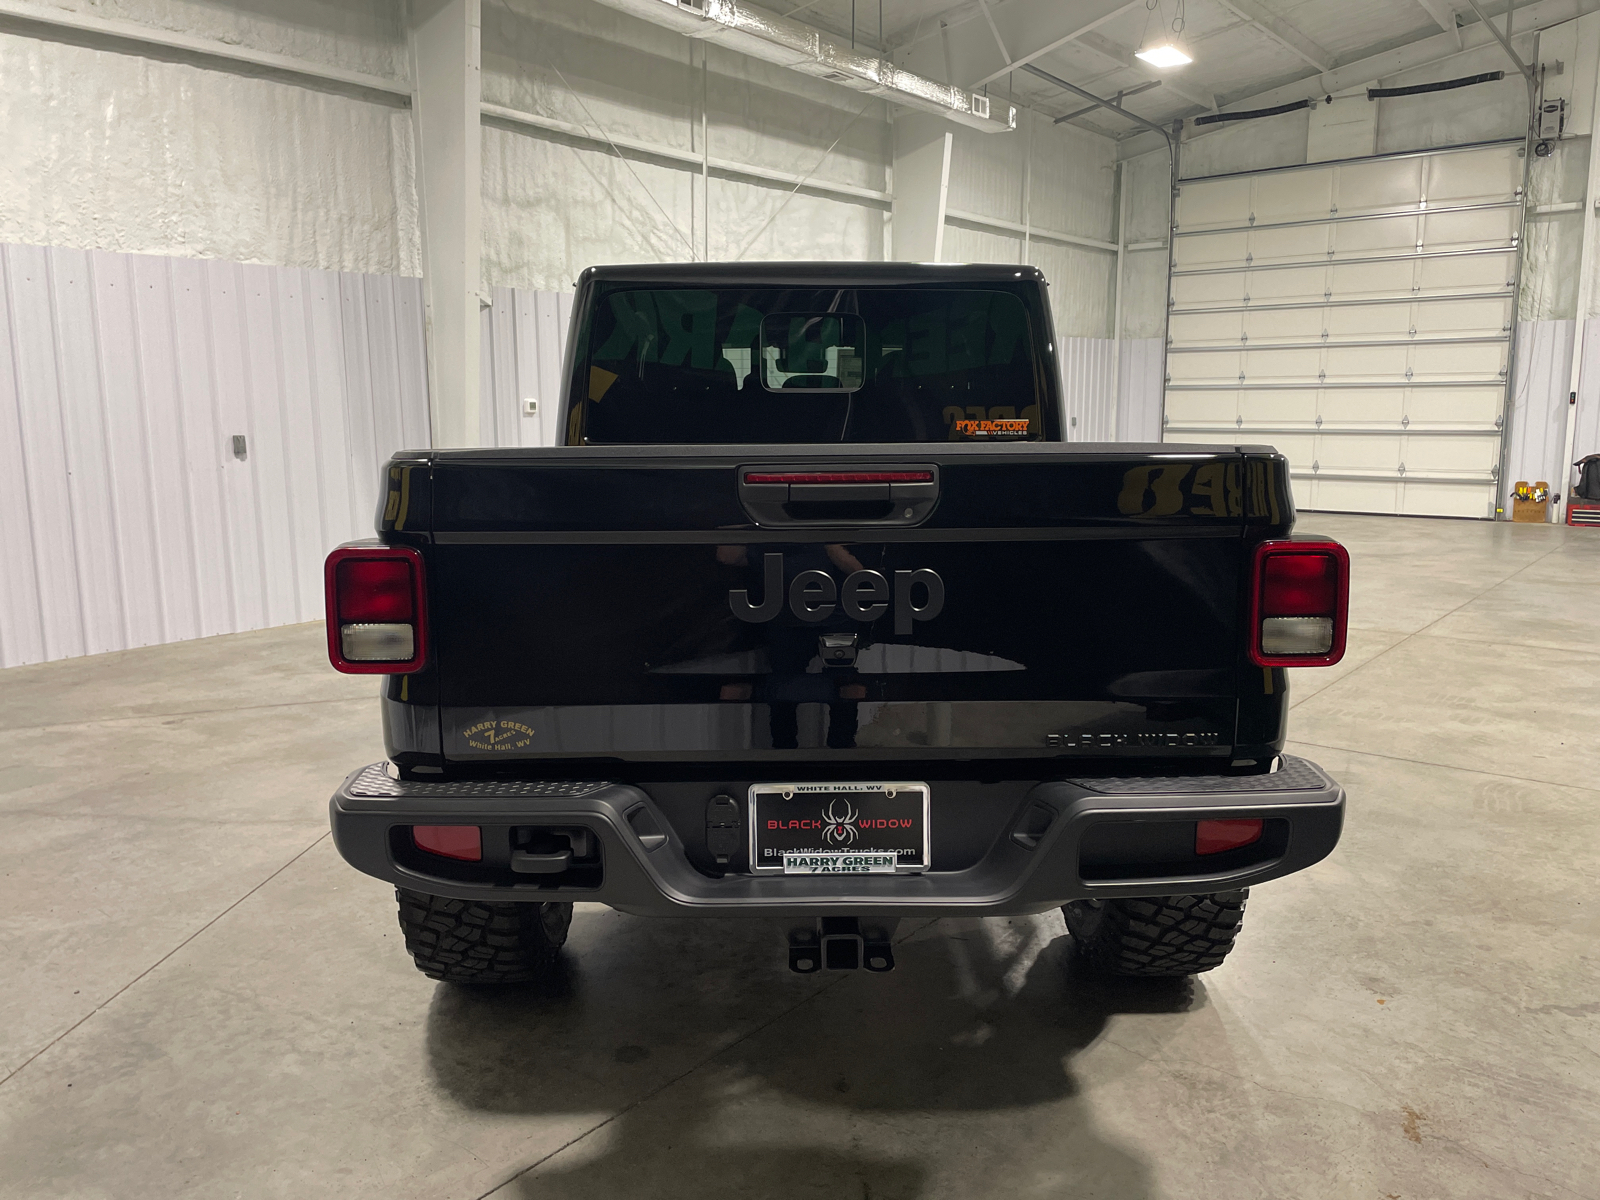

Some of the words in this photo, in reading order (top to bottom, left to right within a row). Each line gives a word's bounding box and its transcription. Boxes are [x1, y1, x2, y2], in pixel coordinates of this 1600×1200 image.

[955, 420, 979, 434] FOX
[980, 420, 1029, 431] FACTORY
[729, 552, 945, 635] Jeep
[463, 720, 497, 738] HARRY
[500, 720, 535, 737] GREEN
[484, 729, 495, 744] 7
[495, 729, 516, 742] ACRES
[469, 739, 492, 750] White
[516, 738, 530, 748] WV
[767, 819, 821, 830] BLACK
[858, 819, 912, 829] WIDOW
[764, 847, 916, 857] BlackWidowTruckscom
[786, 857, 840, 867] HARRY
[842, 856, 893, 866] GREEN
